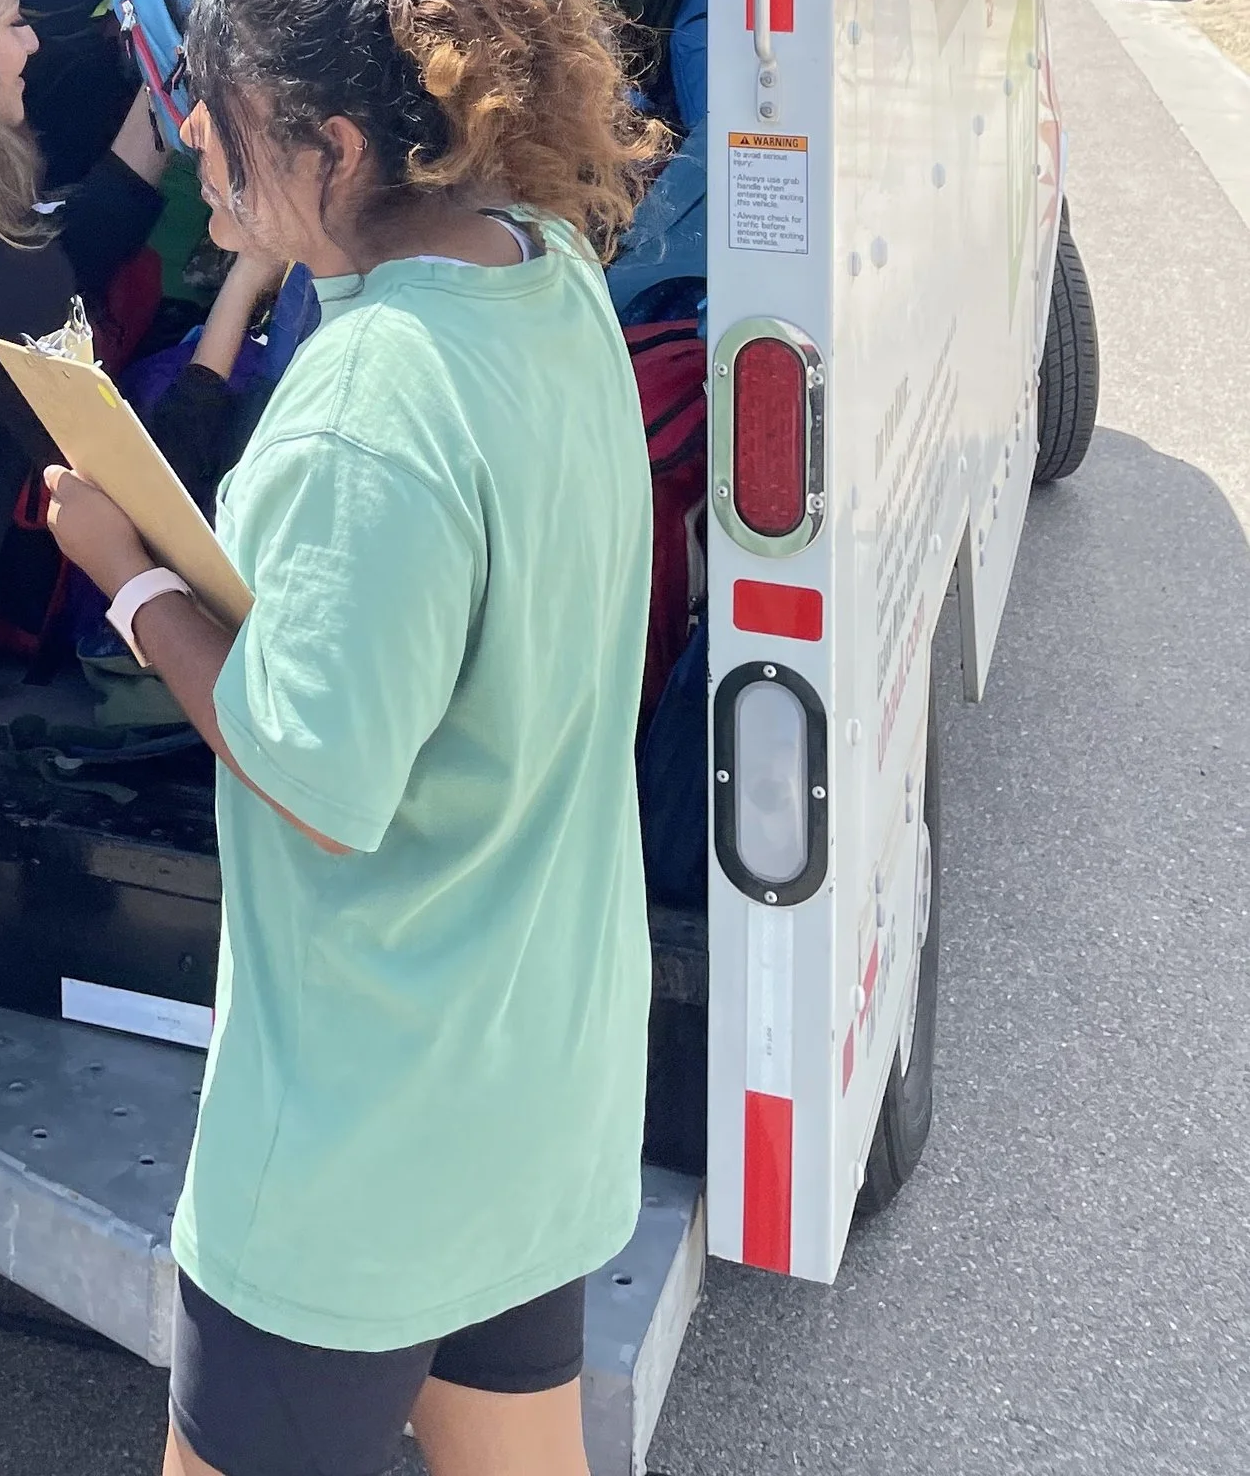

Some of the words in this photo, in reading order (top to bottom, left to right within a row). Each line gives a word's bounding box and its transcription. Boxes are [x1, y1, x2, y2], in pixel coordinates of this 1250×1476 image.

[753, 136, 799, 148] WARNING
[733, 149, 741, 158] To
[742, 151, 761, 159] avoid
[763, 153, 788, 161] serious
[737, 174, 765, 183] Always
[783, 177, 799, 185] grab
[737, 183, 761, 191] handle
[763, 184, 784, 192] when
[737, 191, 767, 201] entering
[779, 194, 804, 204] exiting
[752, 200, 779, 208] vehicle.
[737, 211, 765, 221] Always
[767, 214, 789, 222] check
[737, 221, 759, 229] traffic
[761, 222, 786, 230] before
[737, 229, 767, 239] entering
[779, 232, 804, 242] exiting
[752, 238, 779, 246] vehicle.
